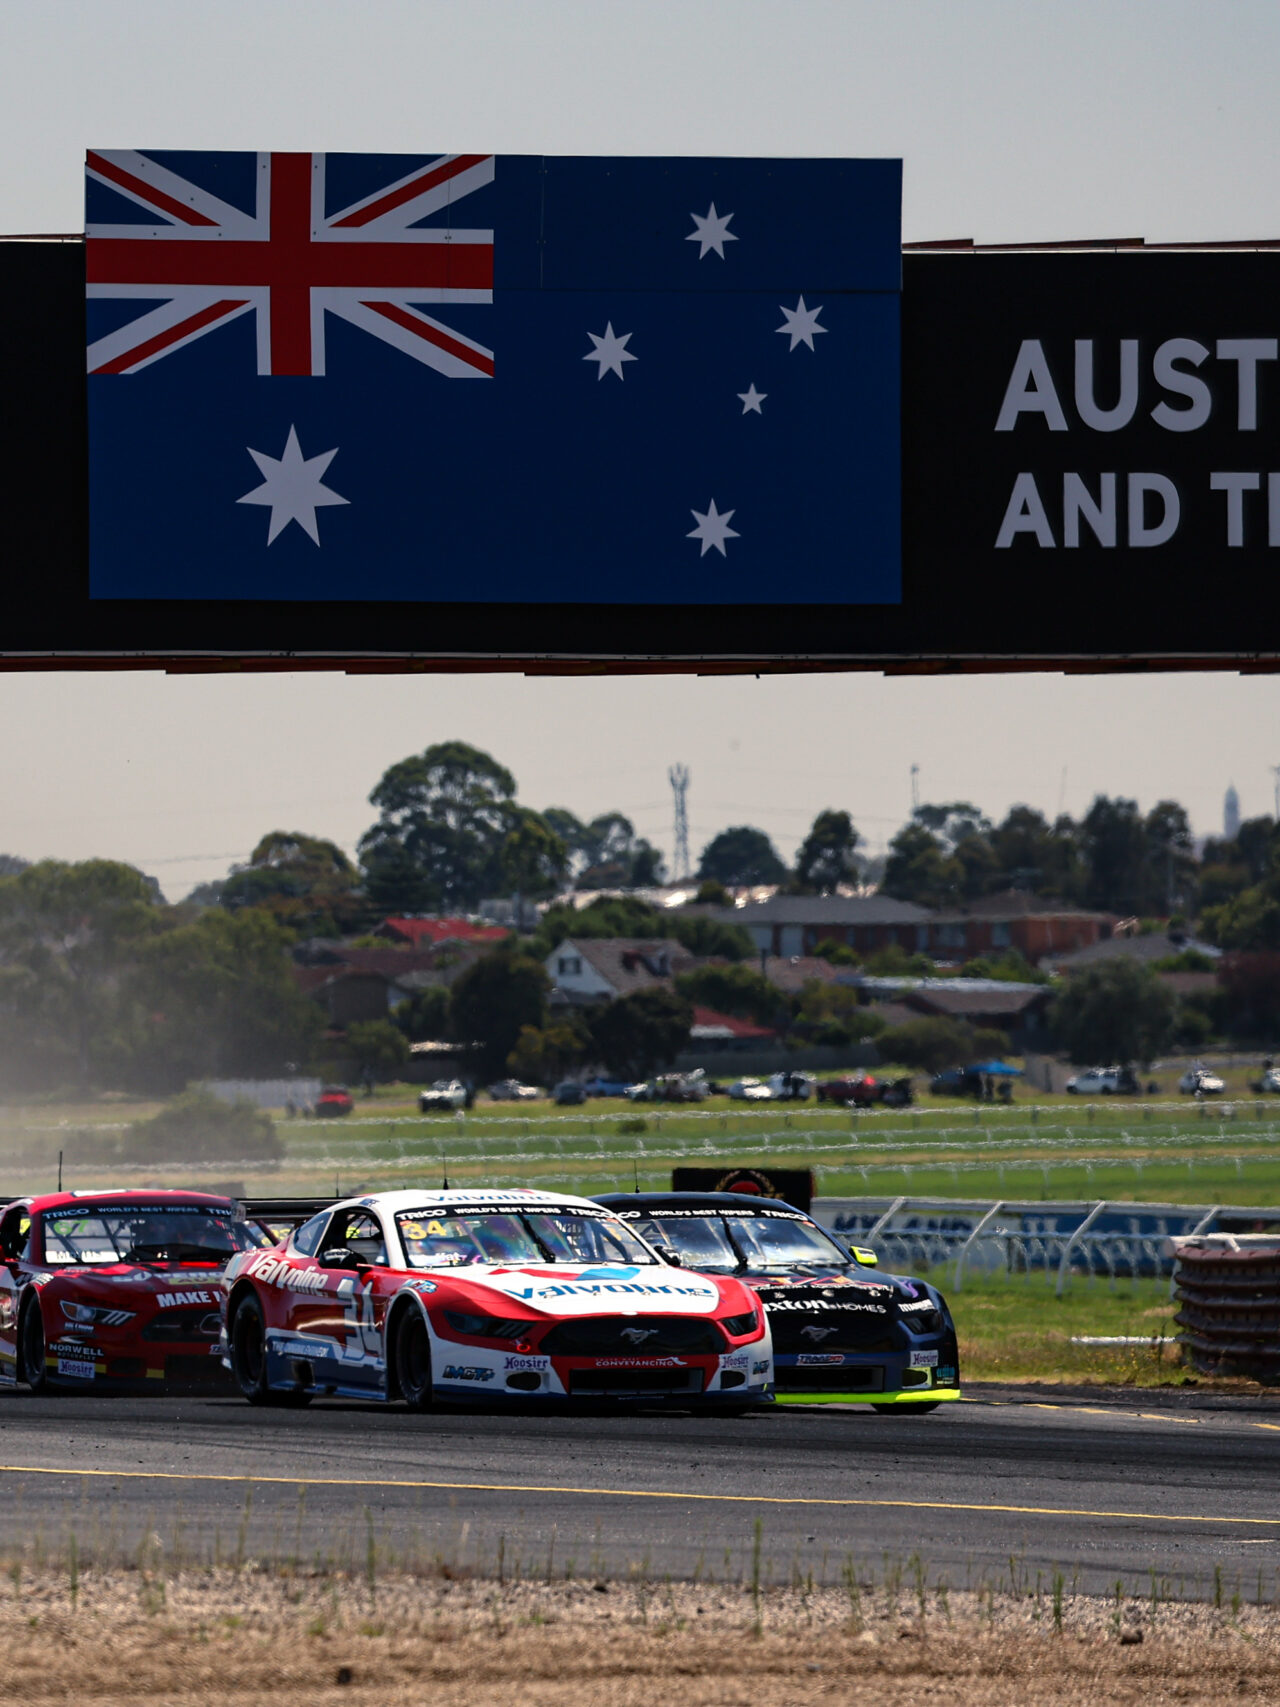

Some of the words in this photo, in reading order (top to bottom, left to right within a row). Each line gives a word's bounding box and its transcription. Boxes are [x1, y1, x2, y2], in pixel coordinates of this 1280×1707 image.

[994, 337, 1279, 432] AUST
[994, 472, 1180, 548] AND
[1210, 472, 1280, 548] T
[42, 1208, 90, 1219] TRICO
[395, 1208, 447, 1220] TRICO
[454, 1206, 498, 1214] WORLD'S
[498, 1206, 523, 1214] BEST
[524, 1206, 562, 1214] WIPERS
[648, 1209, 691, 1217] WORLD'S
[761, 1209, 808, 1221] TRICO
[53, 1219, 89, 1235] 67
[402, 1220, 447, 1240] 34
[503, 1282, 714, 1301] Valvoline
[155, 1290, 212, 1308] MAKE
[836, 1303, 887, 1314] HOMES
[48, 1343, 105, 1356] NORWELL
[503, 1356, 548, 1370] Hoosier
[722, 1355, 749, 1369] Hoosier
